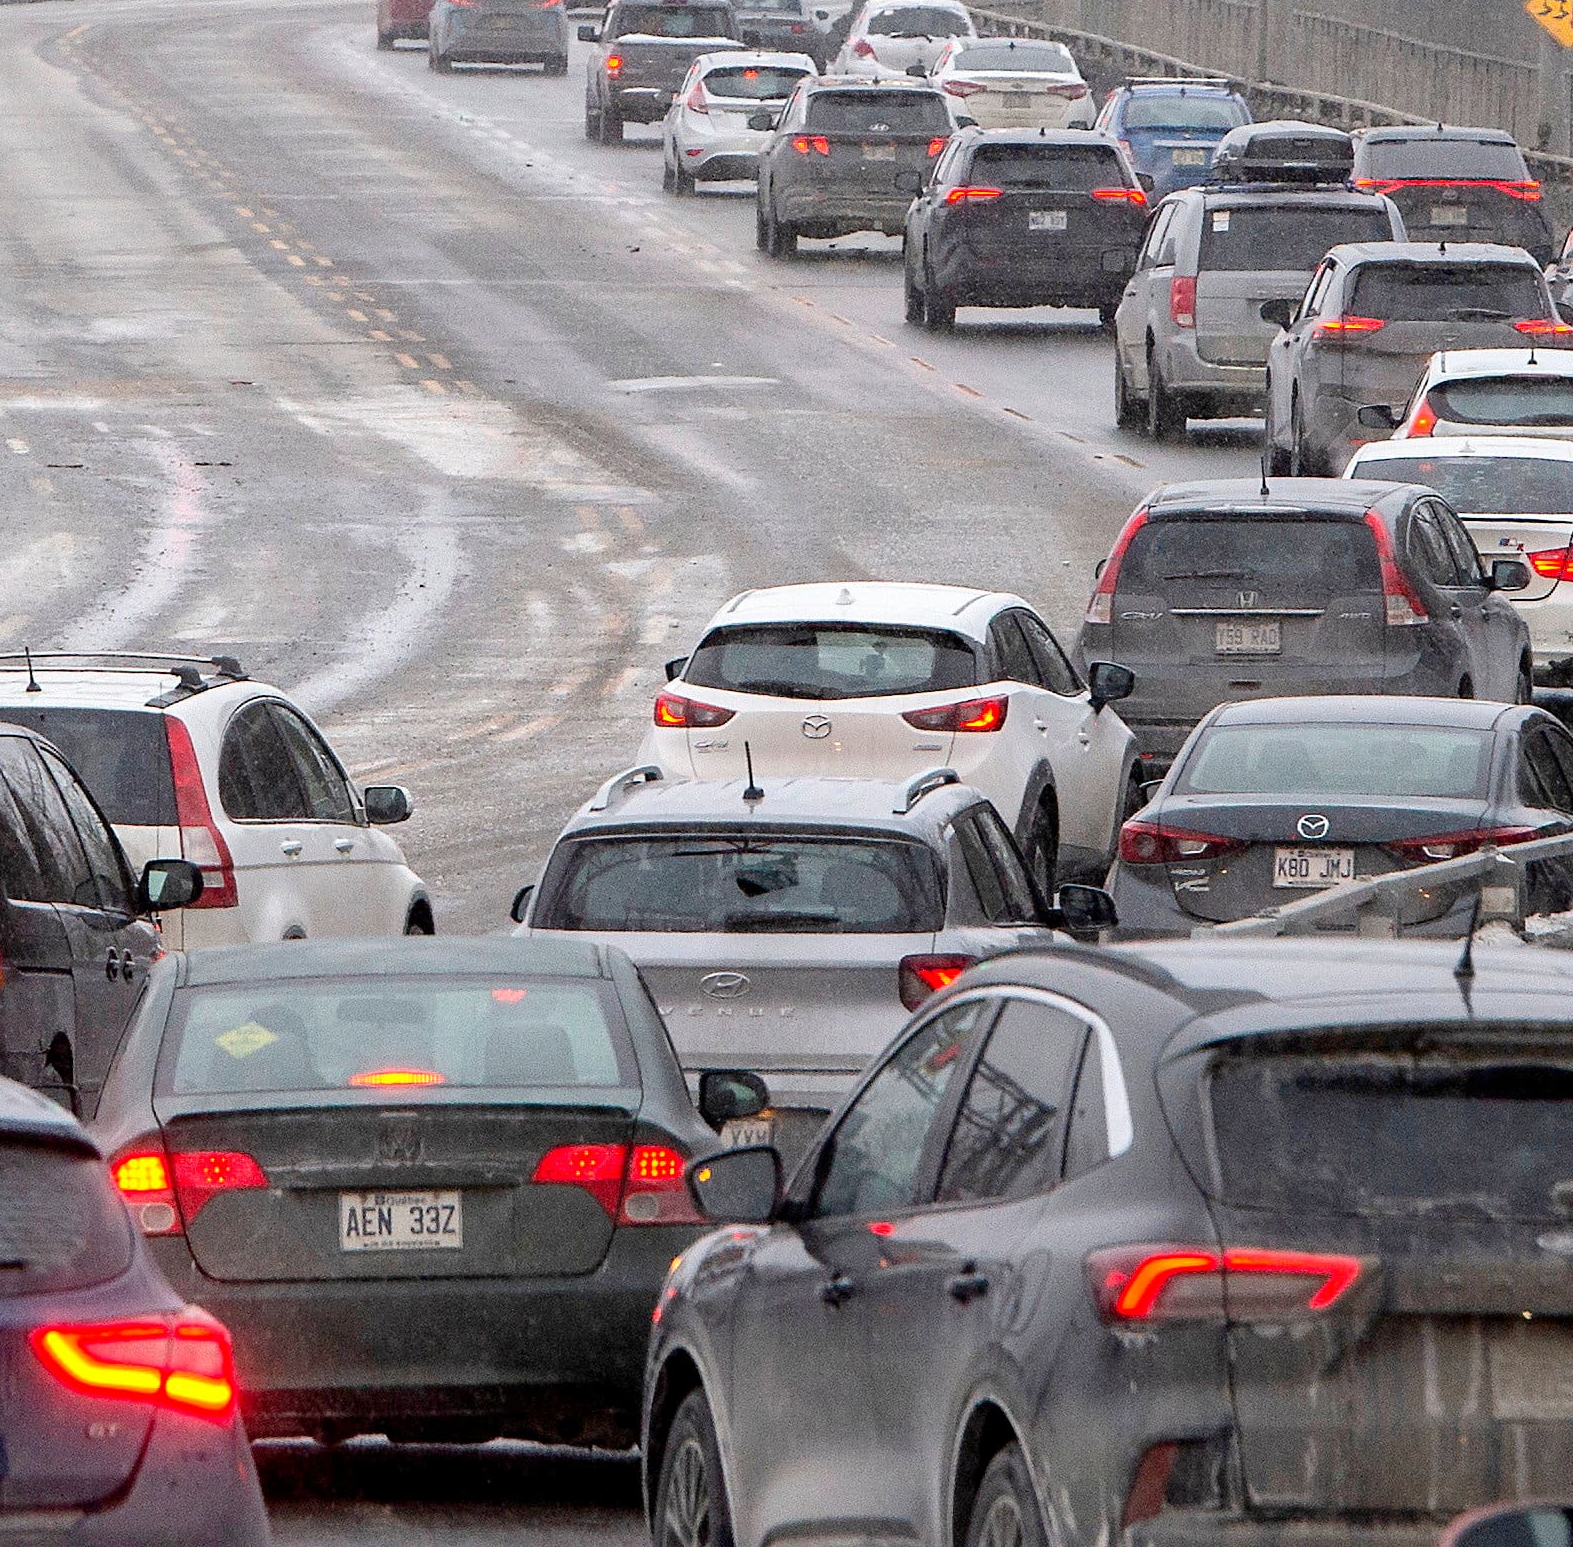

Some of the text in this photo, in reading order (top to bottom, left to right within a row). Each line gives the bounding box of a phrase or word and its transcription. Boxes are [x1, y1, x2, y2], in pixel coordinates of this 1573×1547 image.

[658, 1005, 796, 1018] VENUE
[346, 1203, 456, 1237] AEN 33Z
